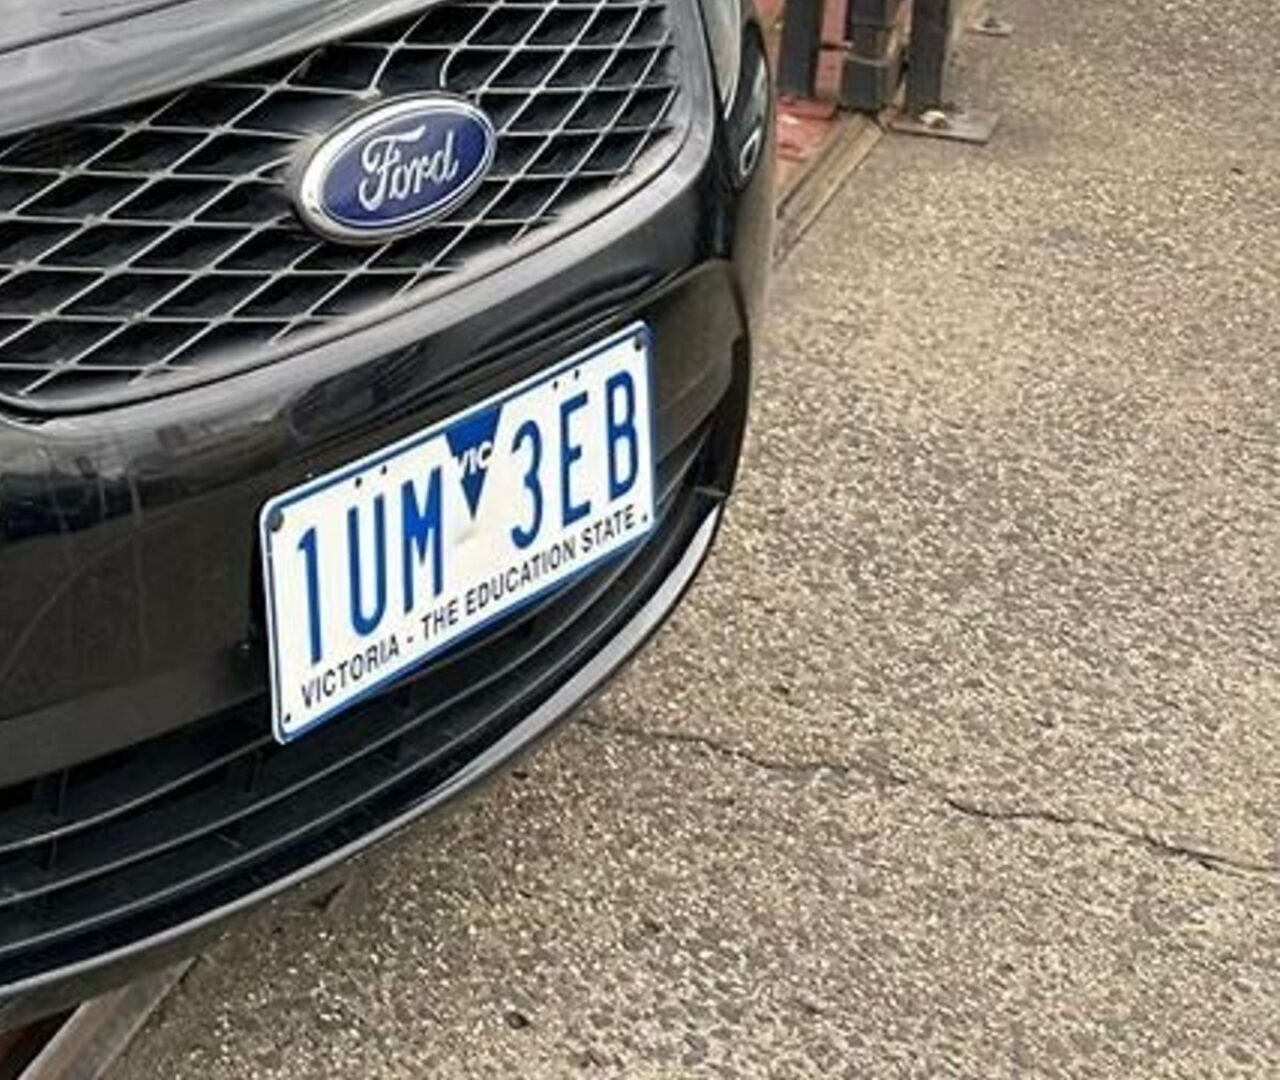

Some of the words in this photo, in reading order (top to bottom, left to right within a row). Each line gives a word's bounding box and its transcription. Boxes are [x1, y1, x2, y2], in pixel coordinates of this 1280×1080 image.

[358, 124, 460, 211] Ford
[297, 464, 445, 666] 1UM
[511, 368, 640, 550] 3EB
[453, 440, 493, 475] VIC
[301, 634, 400, 709] VICTORIA
[420, 597, 459, 640] THE
[465, 540, 576, 617] EDUCATION
[580, 503, 636, 554] STATE
